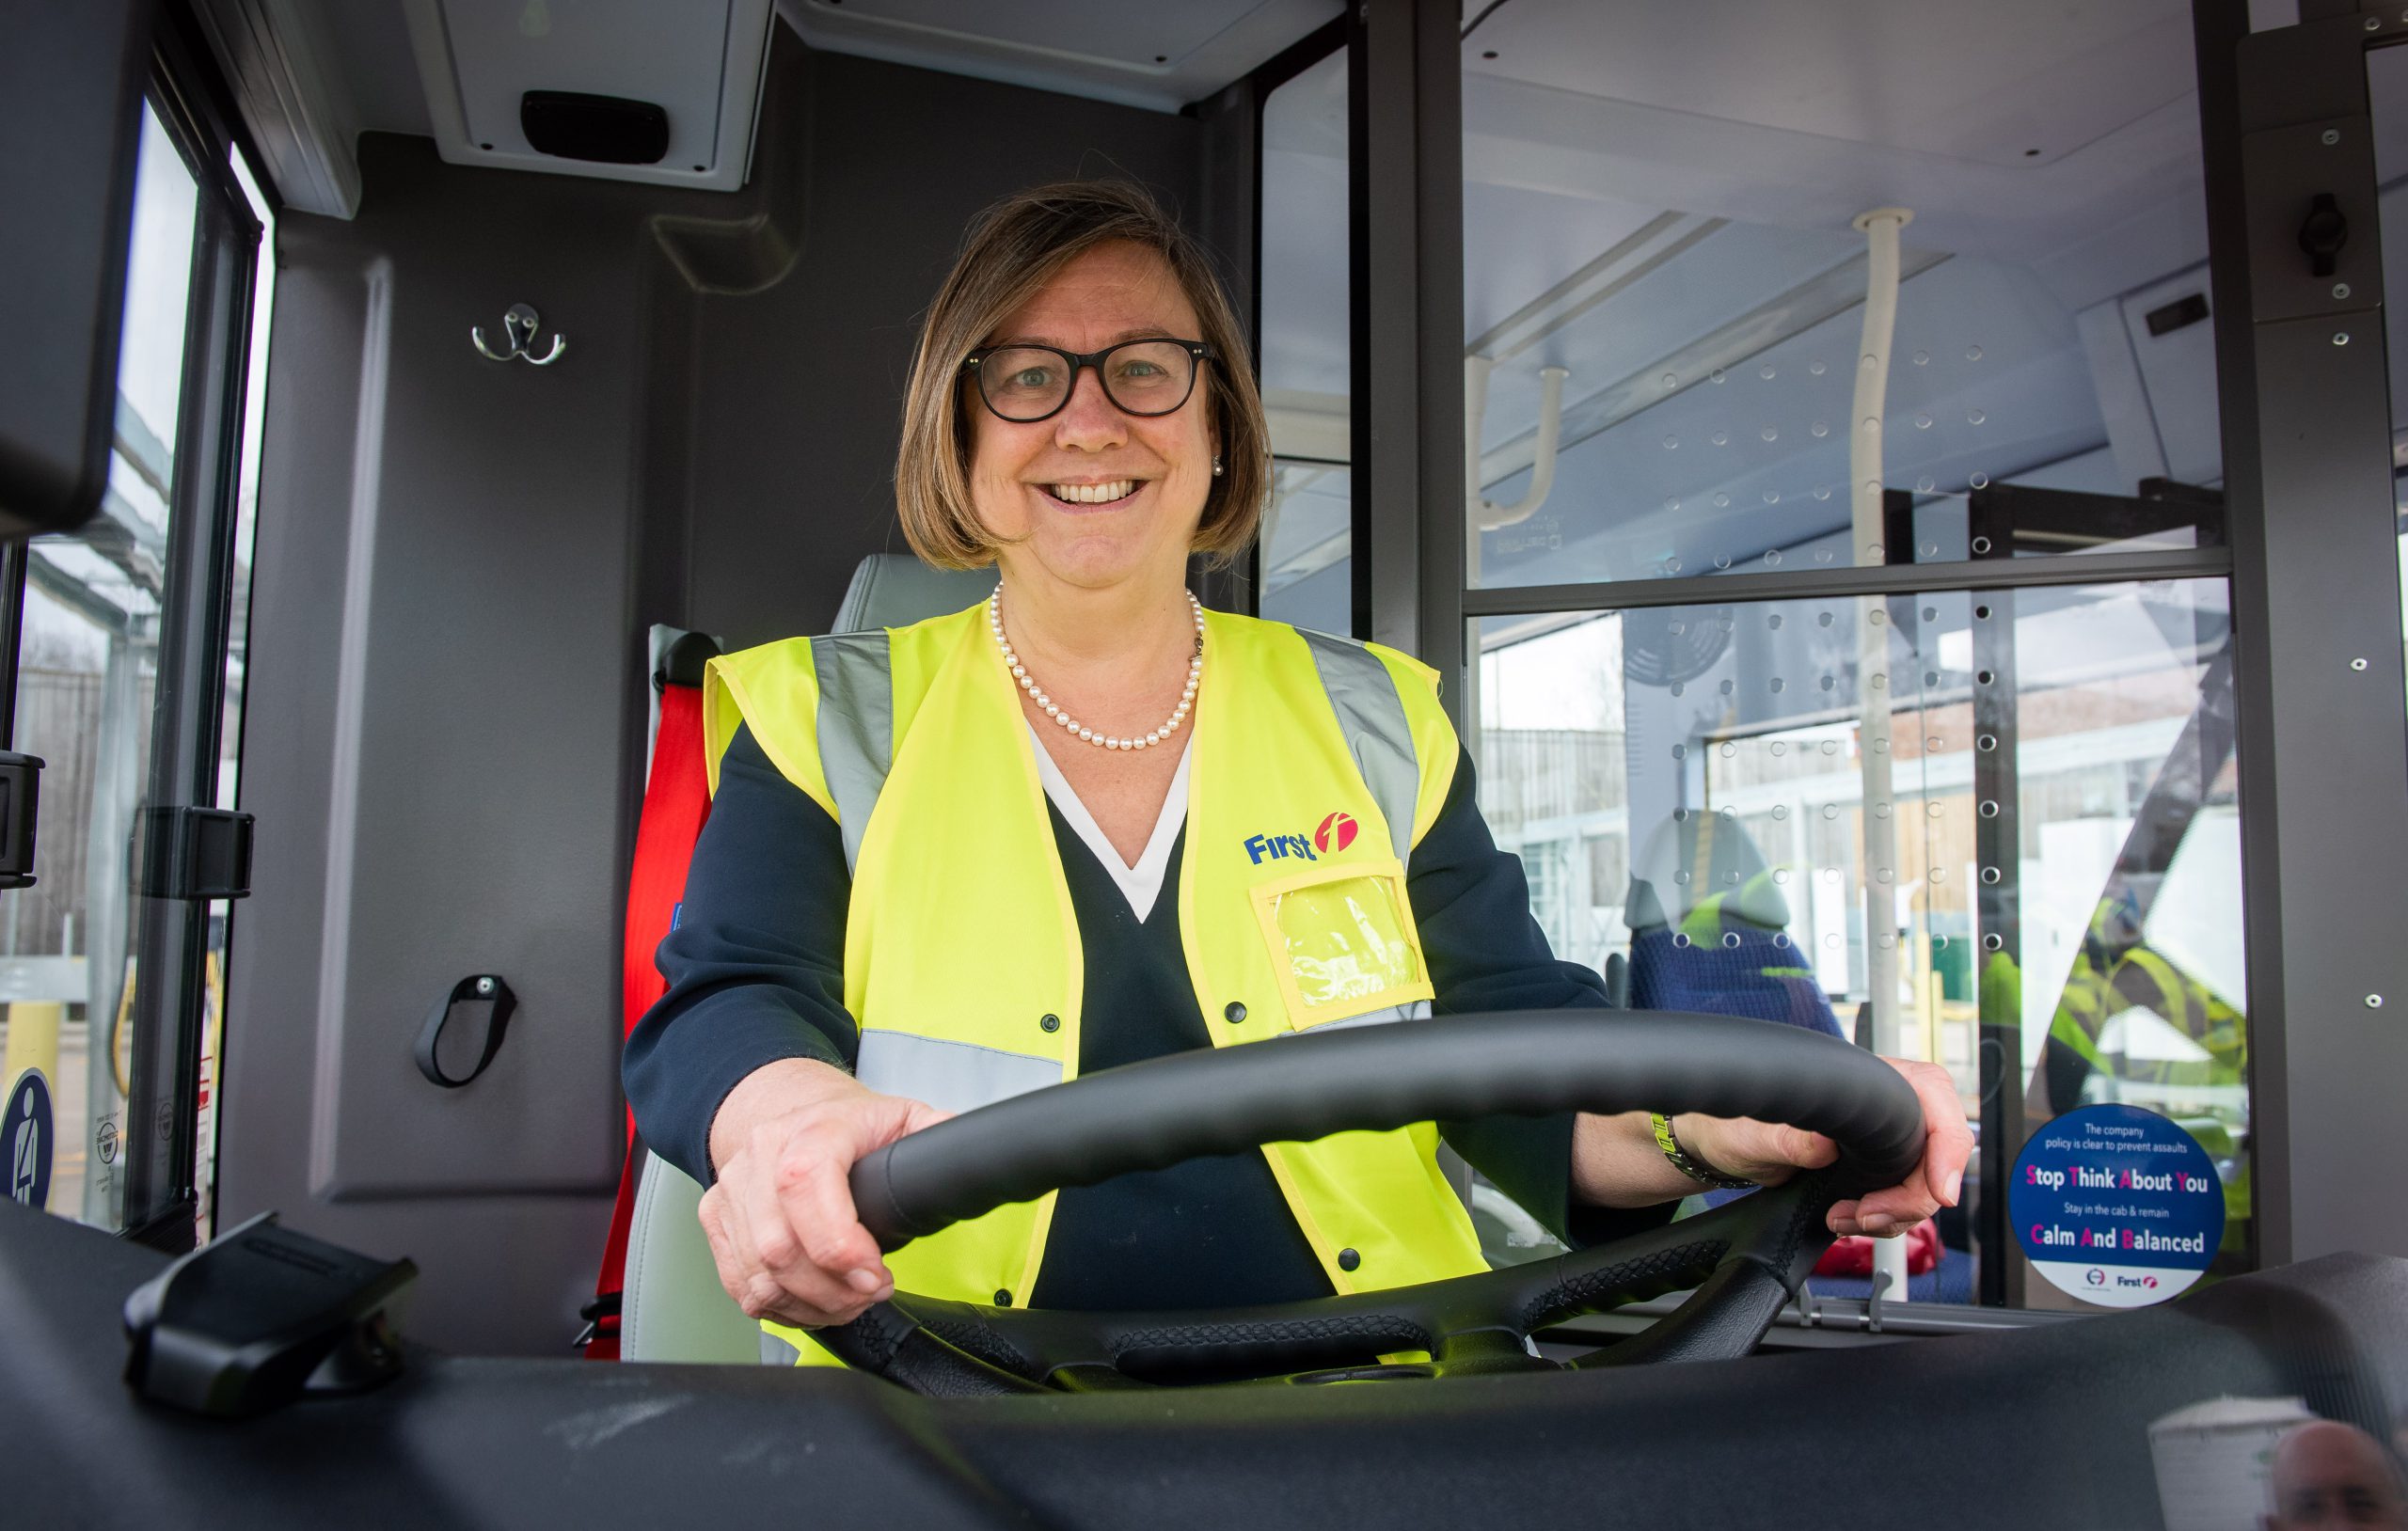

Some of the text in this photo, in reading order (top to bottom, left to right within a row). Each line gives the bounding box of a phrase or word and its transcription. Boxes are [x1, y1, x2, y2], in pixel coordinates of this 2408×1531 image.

[1244, 833, 1317, 865] First
[2085, 1123, 2144, 1139] The company
[2046, 1137, 2187, 1154] policy is clear to prevent assaults
[2026, 1165, 2208, 1193] Stop Think About You
[2065, 1202, 2169, 1219] Stay in the cab & remain
[2031, 1224, 2204, 1253] Calm And Balanced
[2117, 1276, 2142, 1287] First
